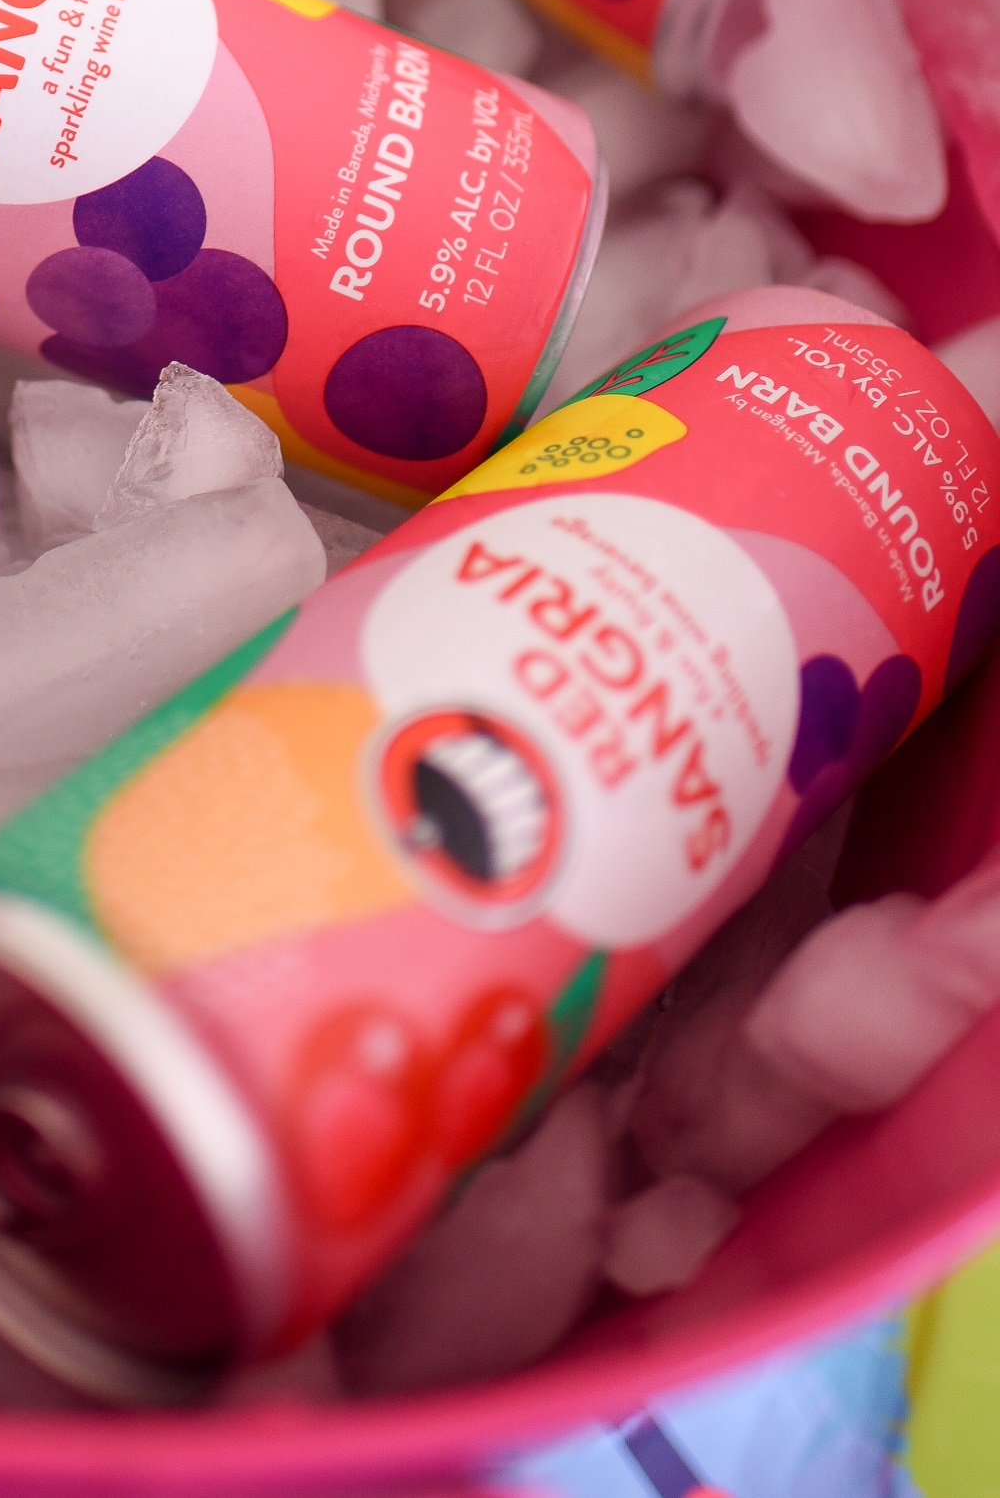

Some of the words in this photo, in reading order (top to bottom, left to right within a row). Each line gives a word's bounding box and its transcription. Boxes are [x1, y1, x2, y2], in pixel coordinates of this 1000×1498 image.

[59, 9, 84, 28] &
[41, 35, 76, 75] fun
[42, 80, 58, 95] a
[50, 58, 112, 169] sparkling
[92, 4, 121, 53] wine
[357, 57, 390, 118] Michigan
[338, 121, 376, 183] Baroda,
[466, 128, 501, 163] by
[502, 108, 534, 175] 355mL
[329, 133, 415, 301] ROUND
[387, 41, 430, 130] BARN
[331, 187, 352, 205] in
[500, 171, 525, 193] /
[450, 170, 489, 233] ALC.
[489, 190, 521, 232] OZ
[310, 206, 345, 260] Made
[475, 242, 508, 276] FL.
[419, 237, 468, 313] 5.9%
[463, 278, 495, 306] 12
[787, 336, 846, 378] VOL.
[822, 327, 902, 388] 355mL
[715, 364, 845, 445] BARN
[724, 393, 748, 411] by
[852, 375, 888, 409] by
[898, 389, 920, 398] /
[915, 399, 950, 439] OZ
[751, 405, 827, 465] Michigan
[892, 406, 942, 466] ALC.
[955, 439, 978, 481] FL.
[829, 461, 879, 529] Baroda,
[939, 470, 979, 550] 5.9%
[971, 480, 991, 514] 12
[844, 445, 945, 612] ROUND
[877, 528, 892, 550] in
[889, 548, 915, 602] Made
[457, 540, 732, 874] SANGRIA
[513, 647, 638, 794] RED
